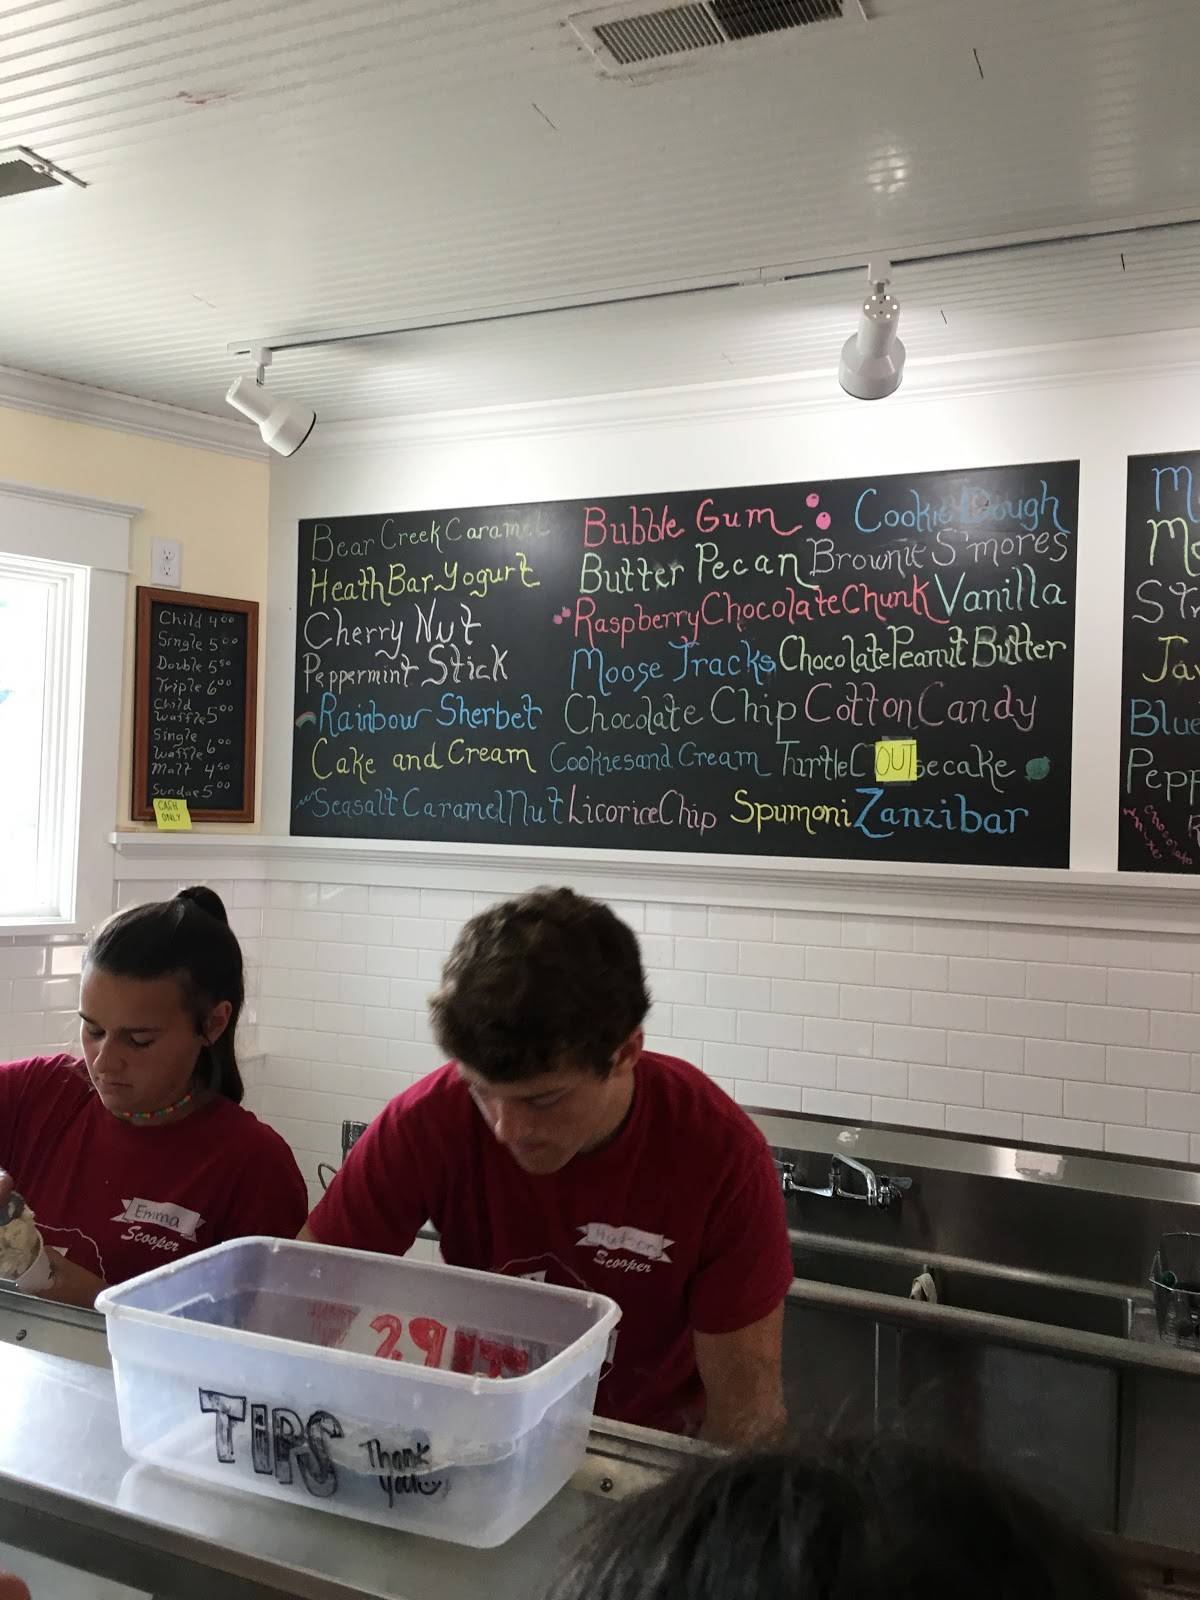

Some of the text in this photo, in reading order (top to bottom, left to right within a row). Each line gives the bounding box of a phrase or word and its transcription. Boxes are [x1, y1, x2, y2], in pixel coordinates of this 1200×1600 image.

[855, 480, 1071, 533] Cookie Dough
[1152, 466, 1200, 523] M
[312, 508, 551, 562] Bear Creek Caramel
[584, 499, 802, 547] Bubble Gum
[580, 542, 819, 594] Butter Pecan
[806, 528, 1068, 579] Brownie S'mores
[310, 567, 391, 606] Heath
[434, 552, 540, 597] Yogurt
[935, 564, 1067, 617] Vanilla
[160, 610, 202, 628] Child
[304, 598, 481, 659] Cherry Nut
[575, 575, 950, 650] Raspberry Chocolate Chunk
[157, 655, 202, 672] Double
[159, 631, 203, 652] Single
[779, 622, 1066, 676] Chocolate Peanut Butter
[156, 677, 202, 696] Triple
[303, 644, 508, 694] Peppermint Stick
[571, 640, 776, 696] Moose Tracks
[154, 698, 192, 711] Child
[320, 692, 542, 737] Rainbow Sherbet
[565, 685, 797, 740] Chocolate Chip
[805, 681, 1037, 732] Cotton Candy
[153, 728, 197, 749] Single
[312, 738, 536, 784] Cake and Cream
[678, 742, 772, 776] Cream
[776, 741, 848, 779] Turtle
[876, 744, 915, 777] OUT
[312, 787, 564, 827] Seasalt Caramel Nut
[569, 784, 717, 836] Licorice Chip
[730, 789, 851, 835] Spumoni
[854, 787, 1029, 838] Zanzibar
[121, 1226, 179, 1251] Scooper
[135, 1205, 179, 1228] Emma
[593, 1250, 652, 1272] Scooper
[359, 1438, 430, 1473] Thank
